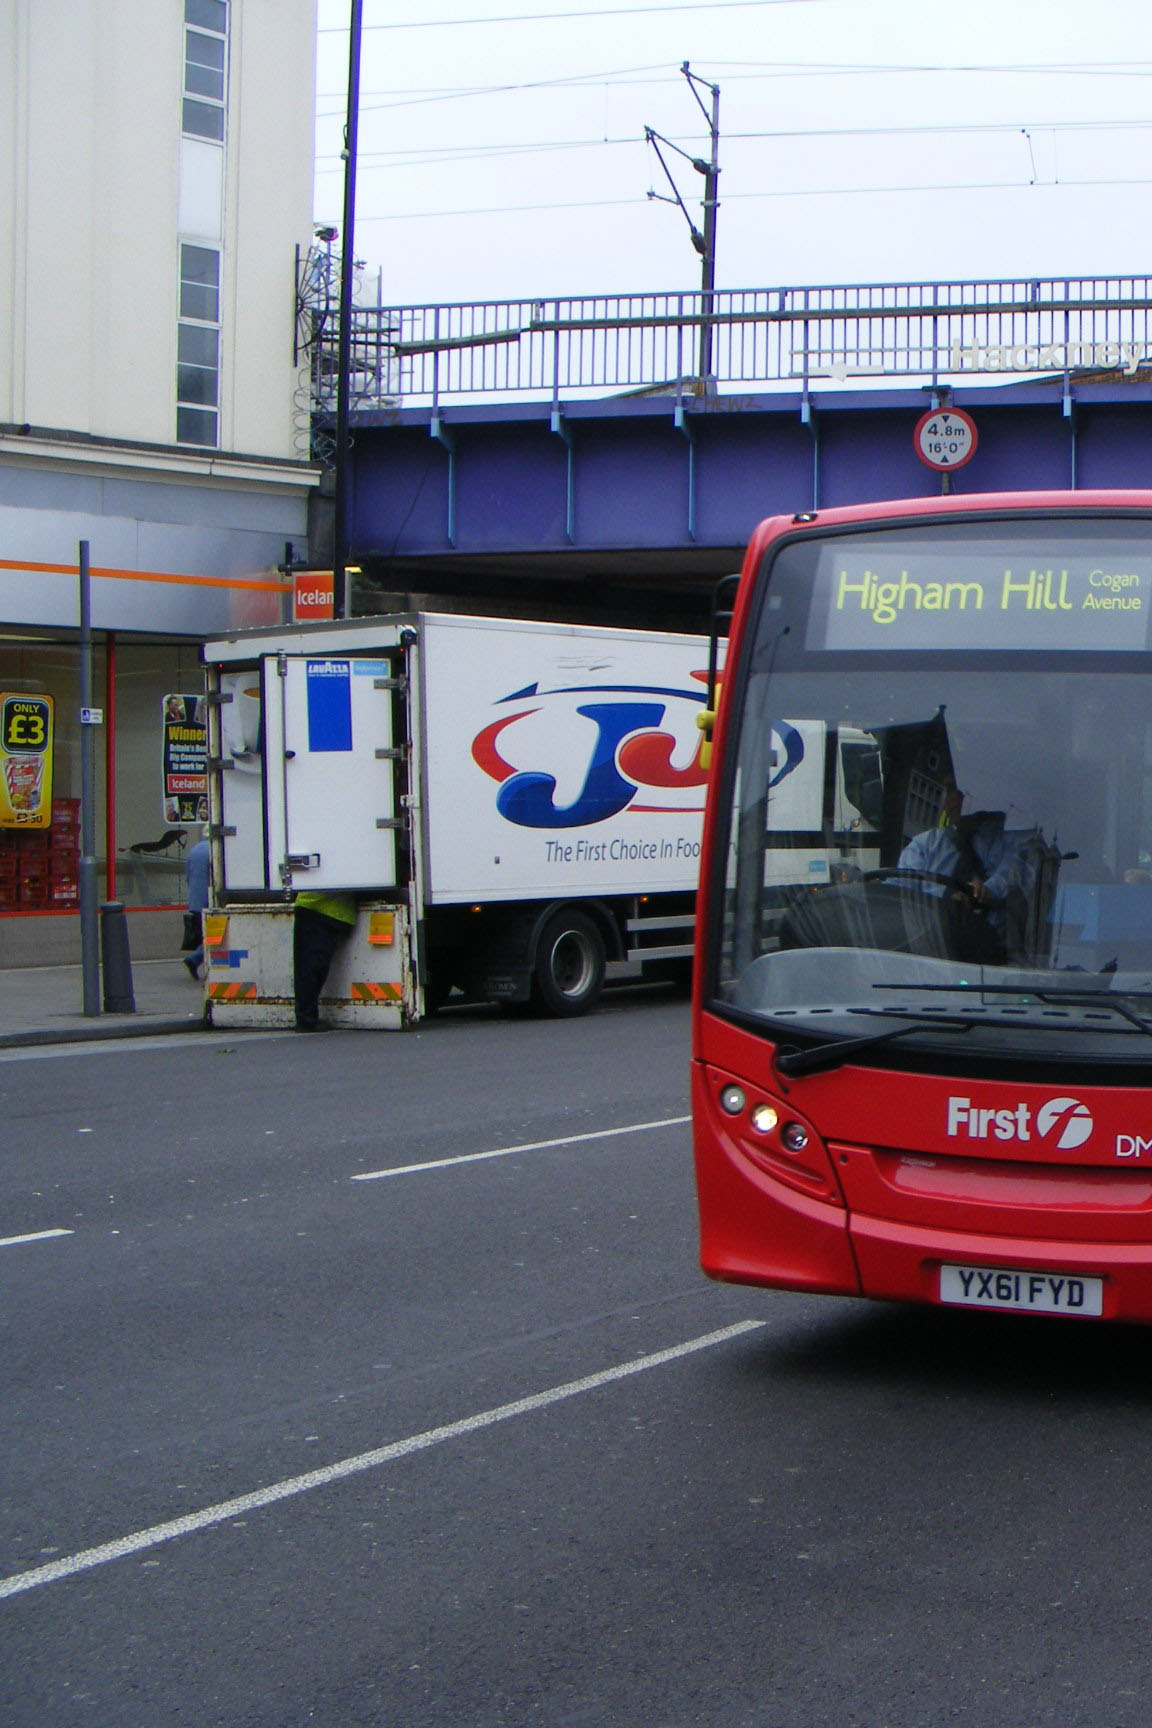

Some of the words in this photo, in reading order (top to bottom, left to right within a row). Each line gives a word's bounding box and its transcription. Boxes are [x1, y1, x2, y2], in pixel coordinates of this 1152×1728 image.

[950, 337, 1145, 375] Hackney
[927, 423, 966, 437] 4.8m
[1088, 569, 1140, 593] Cogan
[297, 588, 334, 606] Icelan
[834, 570, 984, 625] Higham
[1000, 569, 1073, 610] Hill
[1081, 594, 1142, 610] Avenue
[307, 661, 349, 674] LAVAZZA
[13, 703, 40, 713] ONLY
[7, 714, 46, 744] £3
[172, 778, 206, 789] Iceland
[545, 840, 572, 863] The
[576, 840, 606, 862] First
[610, 839, 657, 861] Choice
[660, 838, 673, 859] In
[676, 837, 701, 858] Foo
[947, 1096, 1031, 1141] First
[959, 1270, 1020, 1302] YX61
[1028, 1276, 1084, 1308] FYD
